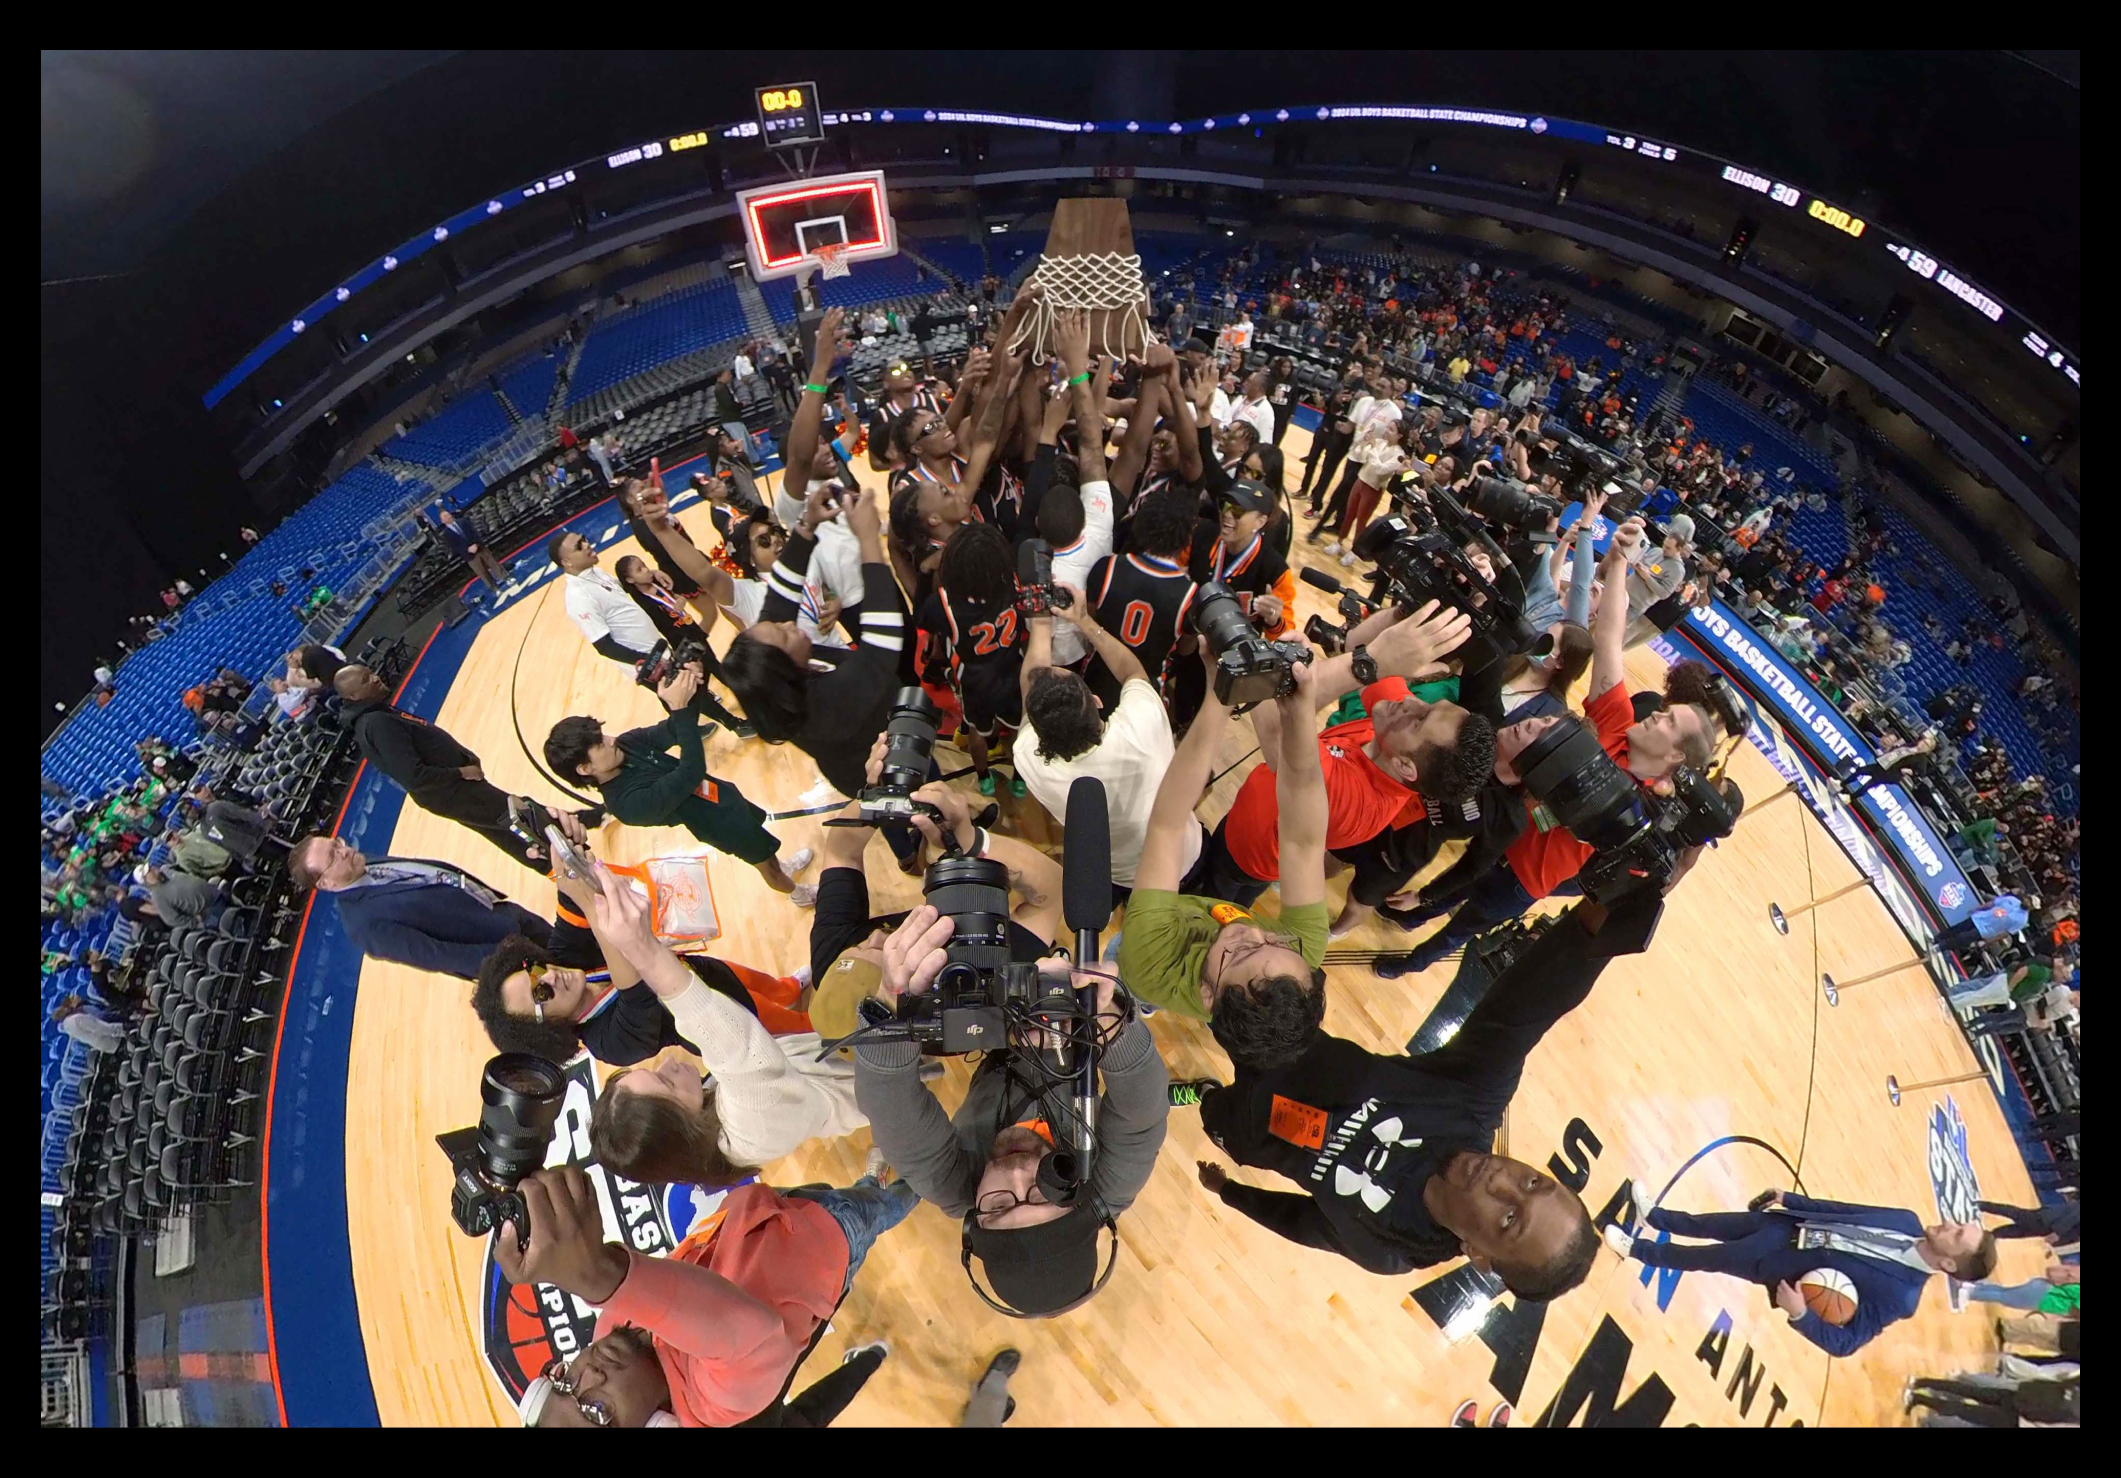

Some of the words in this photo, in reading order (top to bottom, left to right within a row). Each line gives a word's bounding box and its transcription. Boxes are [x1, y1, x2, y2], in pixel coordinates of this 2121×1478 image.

[1362, 107, 1381, 117] BOYS
[1382, 107, 1429, 119] BASKETBALL
[1429, 109, 1454, 120] STATE
[1454, 111, 1527, 127] CHAMPIONSHIPS
[641, 142, 663, 159] 30
[1622, 136, 1636, 150] 3
[1662, 147, 1677, 161] 5
[1721, 165, 1771, 194] ELLISON
[1770, 182, 1801, 207] 30
[1808, 200, 1866, 238] 0:00.0
[1907, 250, 1939, 279] 59
[1936, 269, 2004, 322] LANCASTER
[969, 607, 1018, 656] 22
[1120, 599, 1155, 648] 0
[1691, 605, 1730, 637] OYS
[1722, 628, 1817, 723] BASKETBALL
[1695, 1308, 1804, 1427] ANT
